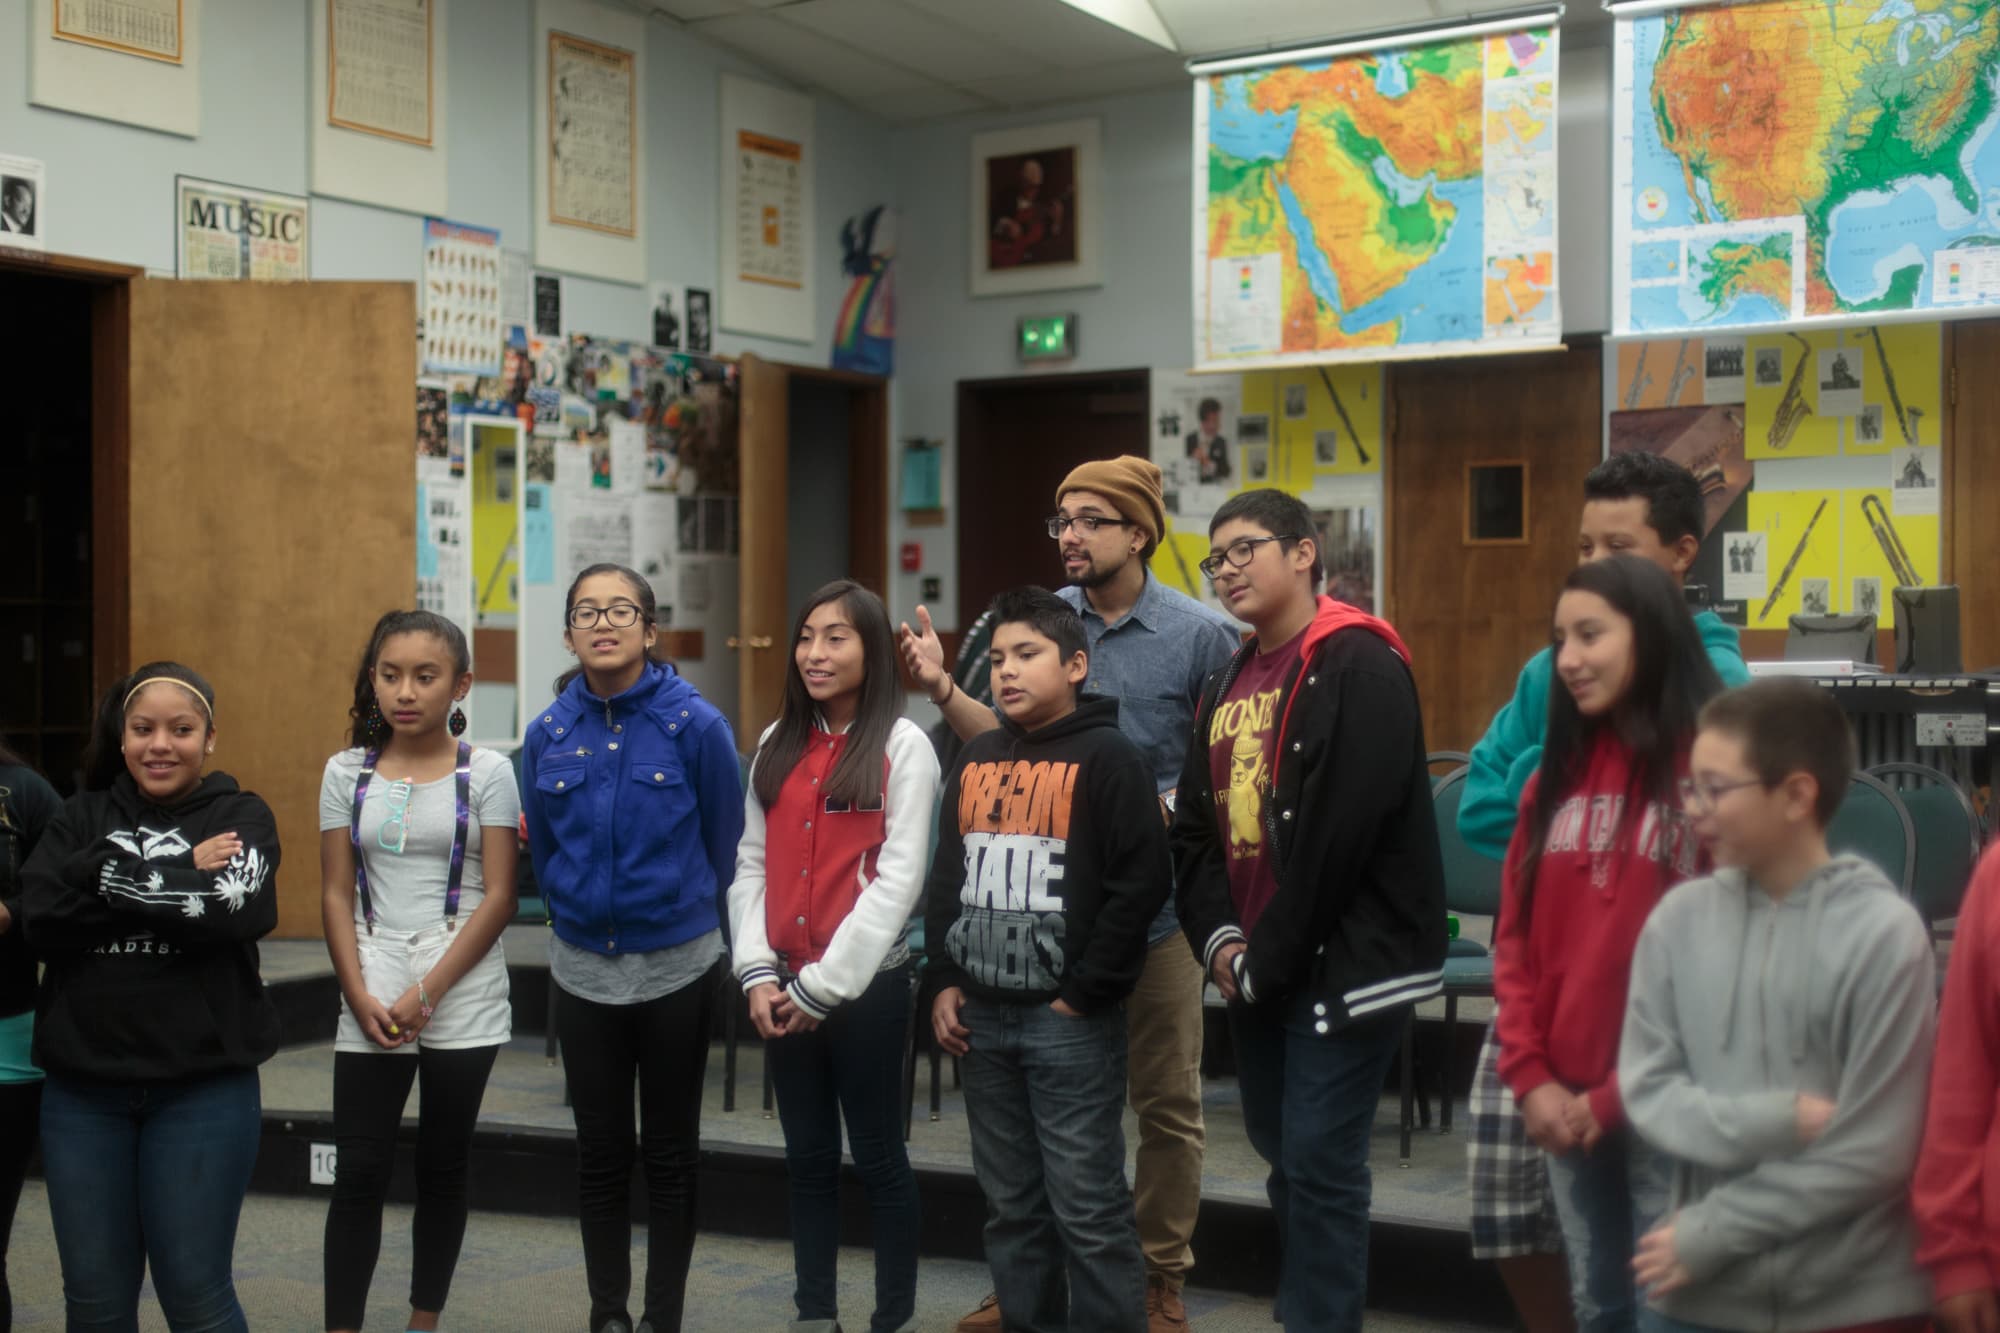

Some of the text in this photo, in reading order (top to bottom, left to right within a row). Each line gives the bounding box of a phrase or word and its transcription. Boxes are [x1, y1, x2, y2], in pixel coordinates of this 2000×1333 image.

[187, 197, 302, 243] MUSIC
[958, 760, 1080, 840] OREGON
[960, 832, 1067, 913] STATE
